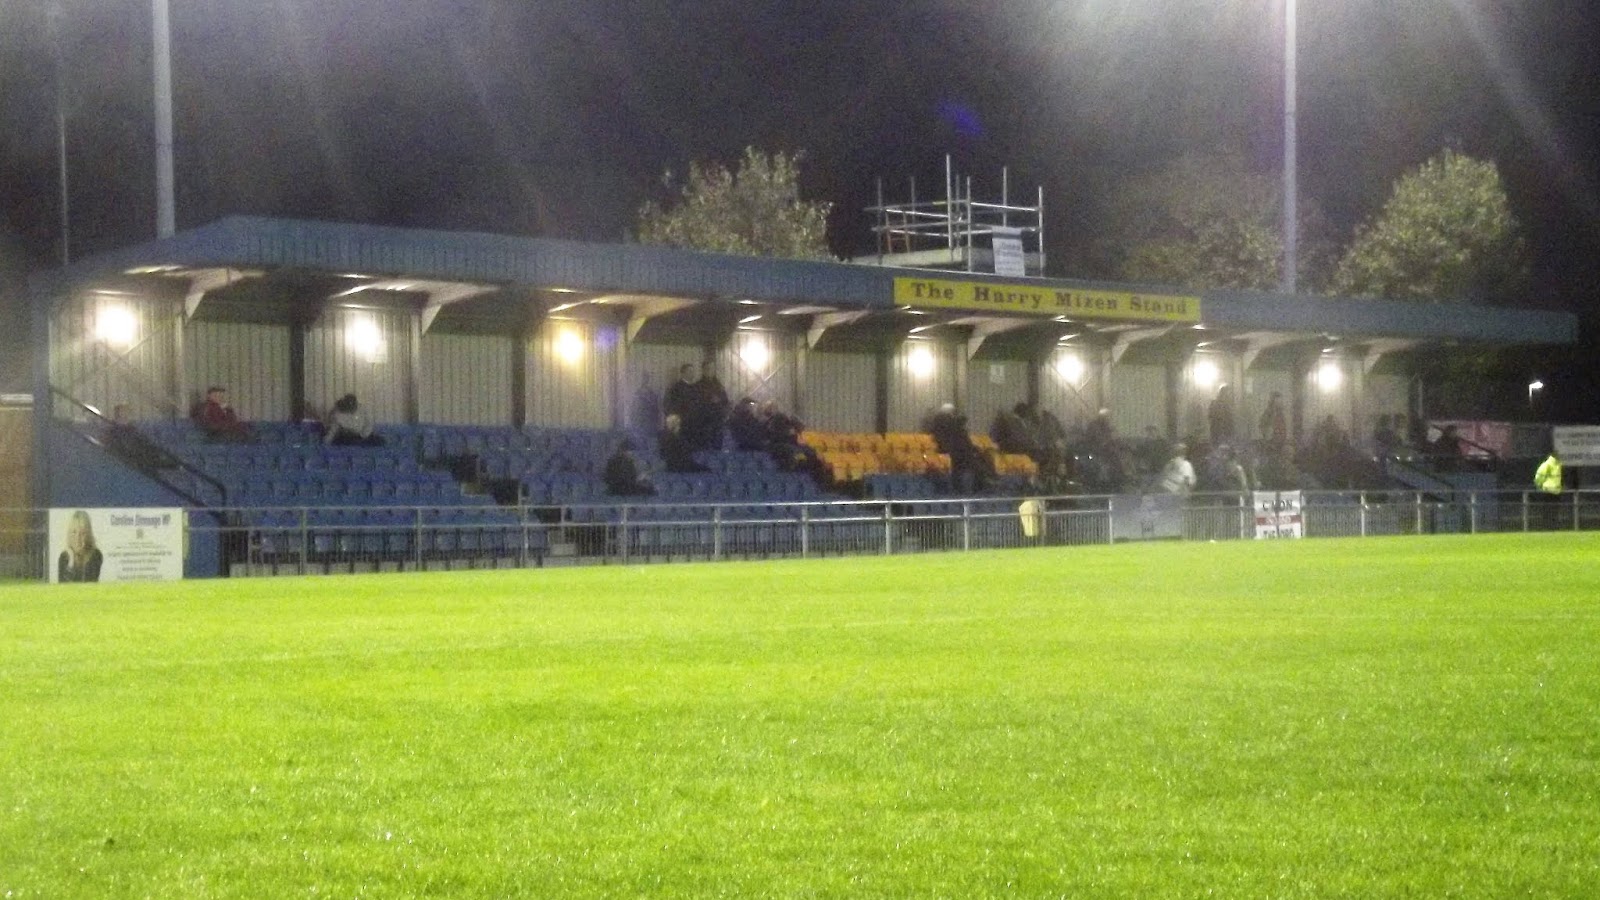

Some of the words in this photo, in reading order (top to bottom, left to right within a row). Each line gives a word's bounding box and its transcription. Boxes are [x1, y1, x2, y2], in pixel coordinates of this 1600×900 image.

[910, 282, 954, 300] The
[974, 286, 1042, 309] Harry
[1055, 292, 1117, 310] Mizen
[1130, 296, 1186, 314] Stand
